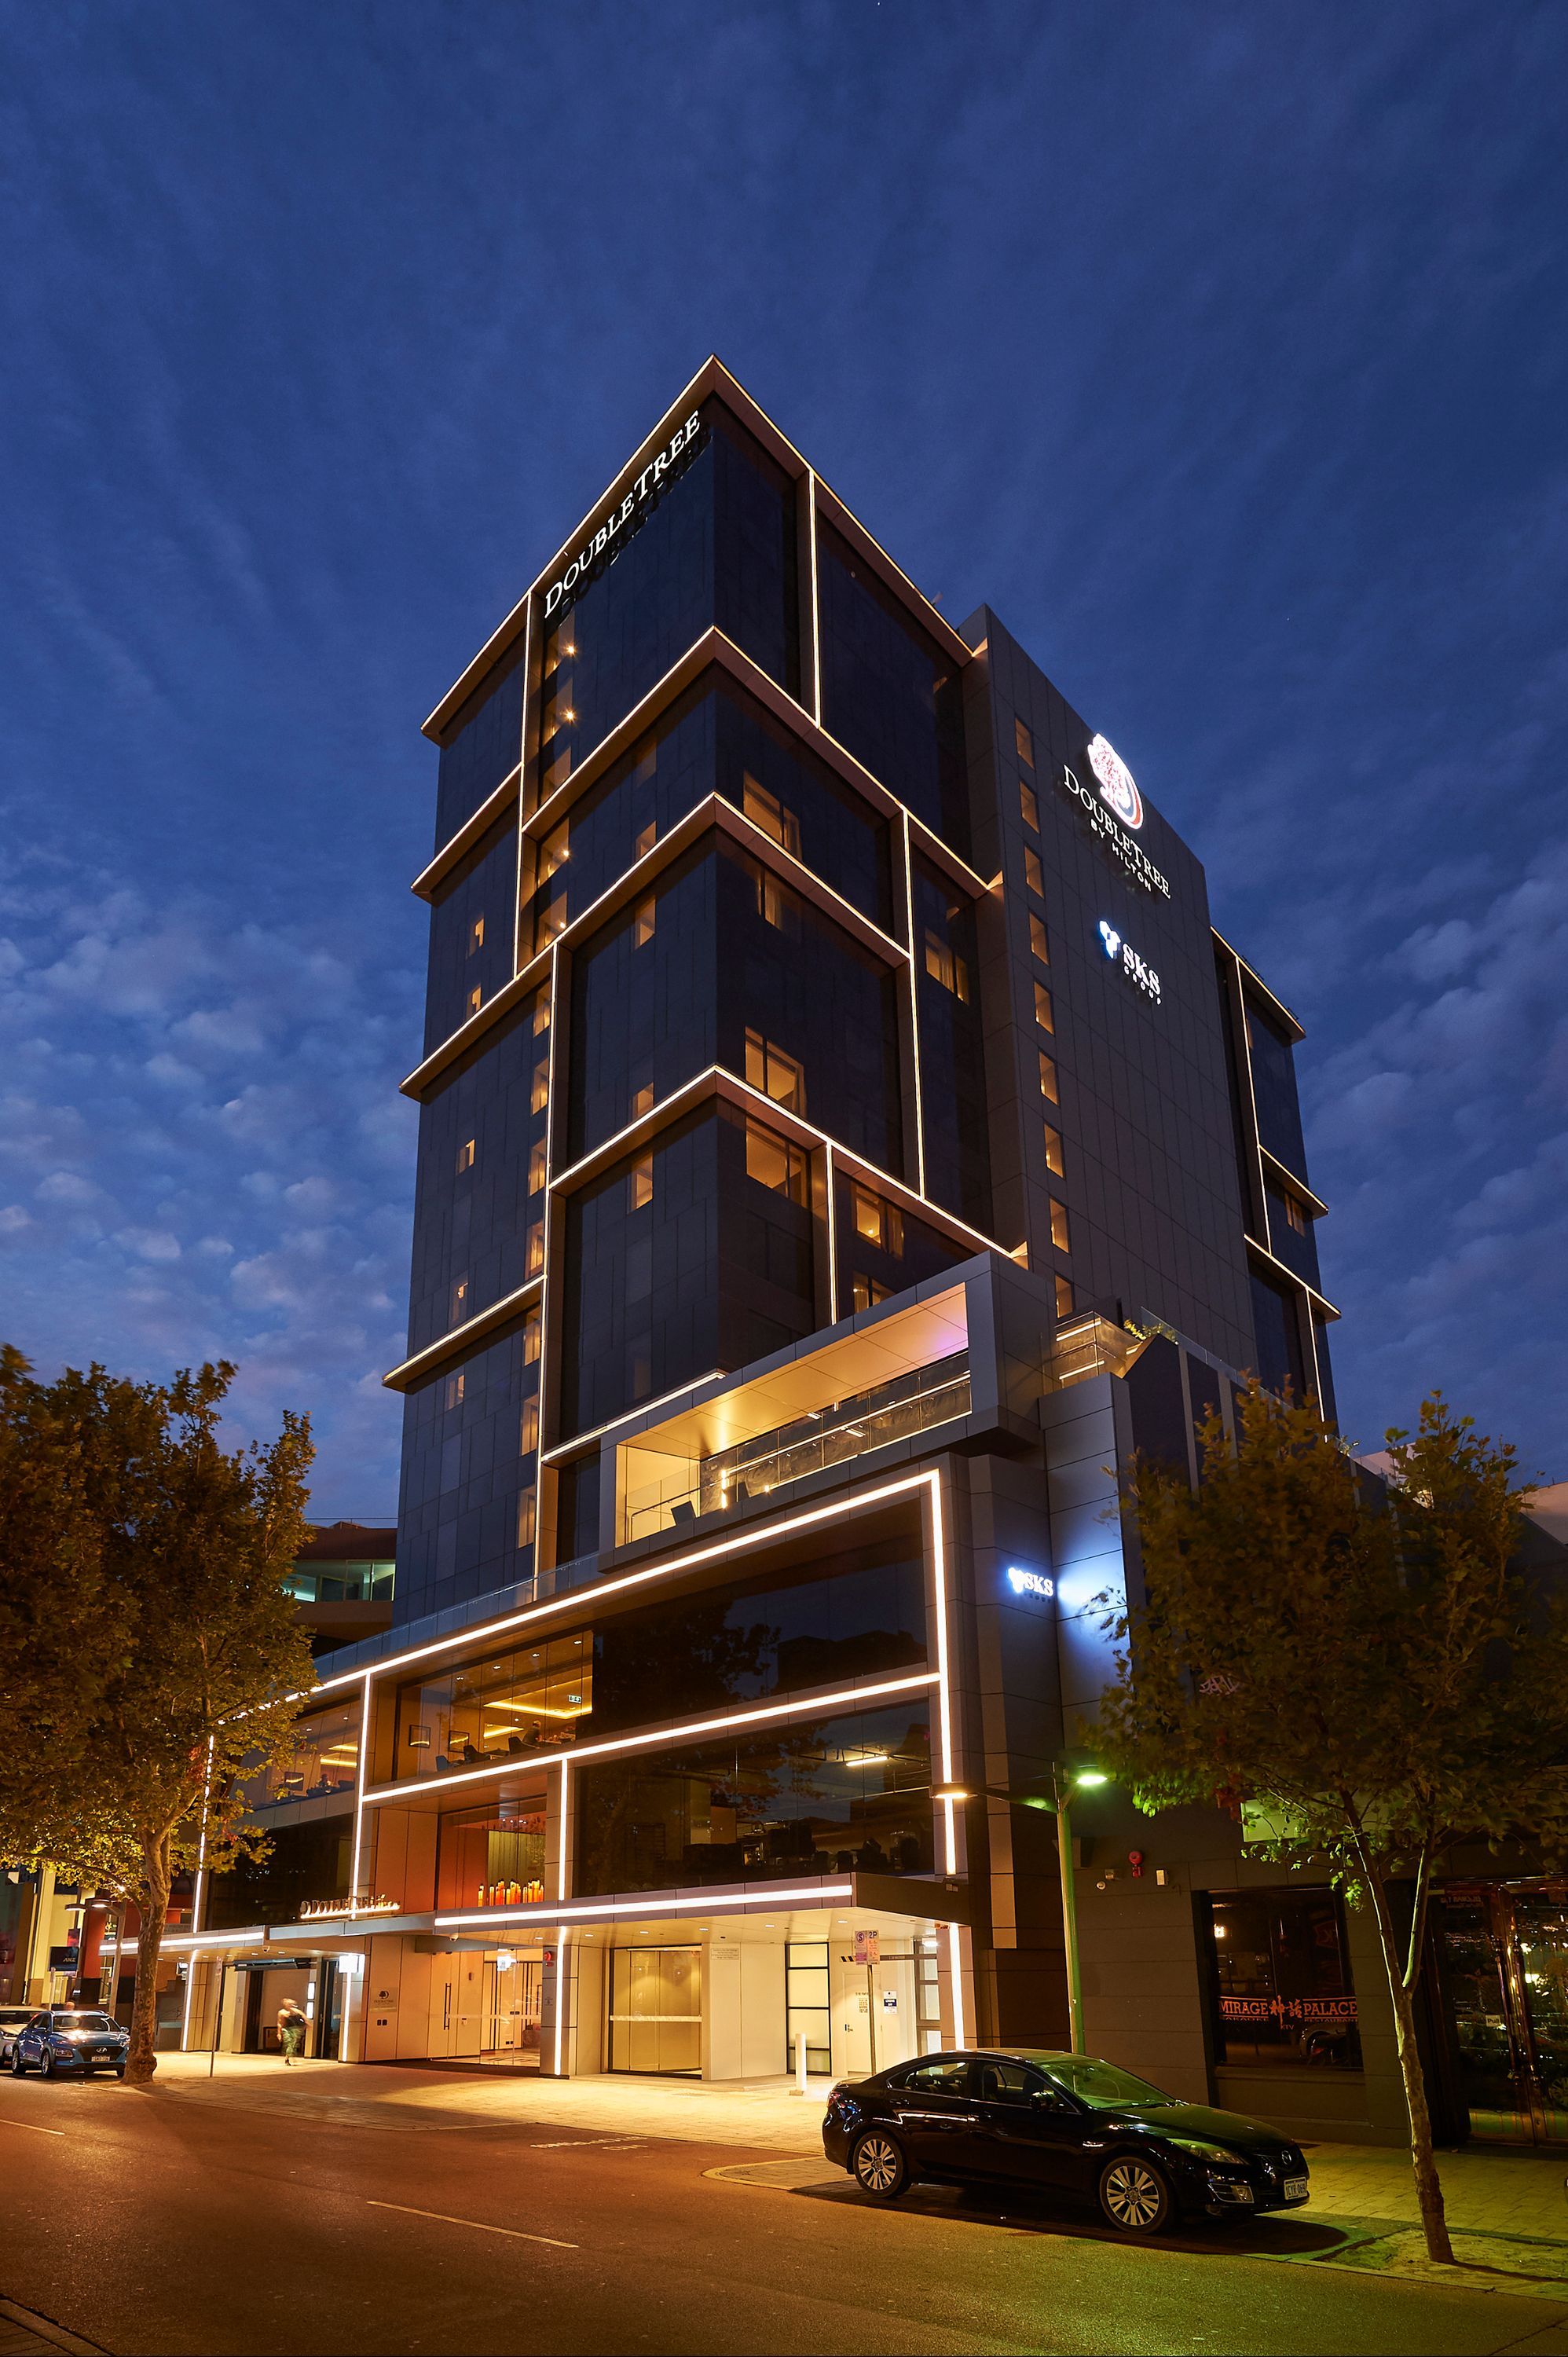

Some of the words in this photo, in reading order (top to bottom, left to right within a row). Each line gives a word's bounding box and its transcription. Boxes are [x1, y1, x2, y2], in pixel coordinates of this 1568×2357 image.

[544, 410, 700, 618] DOUBLETREE
[1064, 764, 1171, 899] DOUBLETREE
[1090, 819, 1105, 838] BY
[1112, 842, 1152, 892] HILTON
[1123, 943, 1160, 995] SKS
[1024, 1572, 1053, 1596] SKS
[1219, 2000, 1268, 2014] MIRAGE
[1303, 2001, 1357, 2016] PALACE
